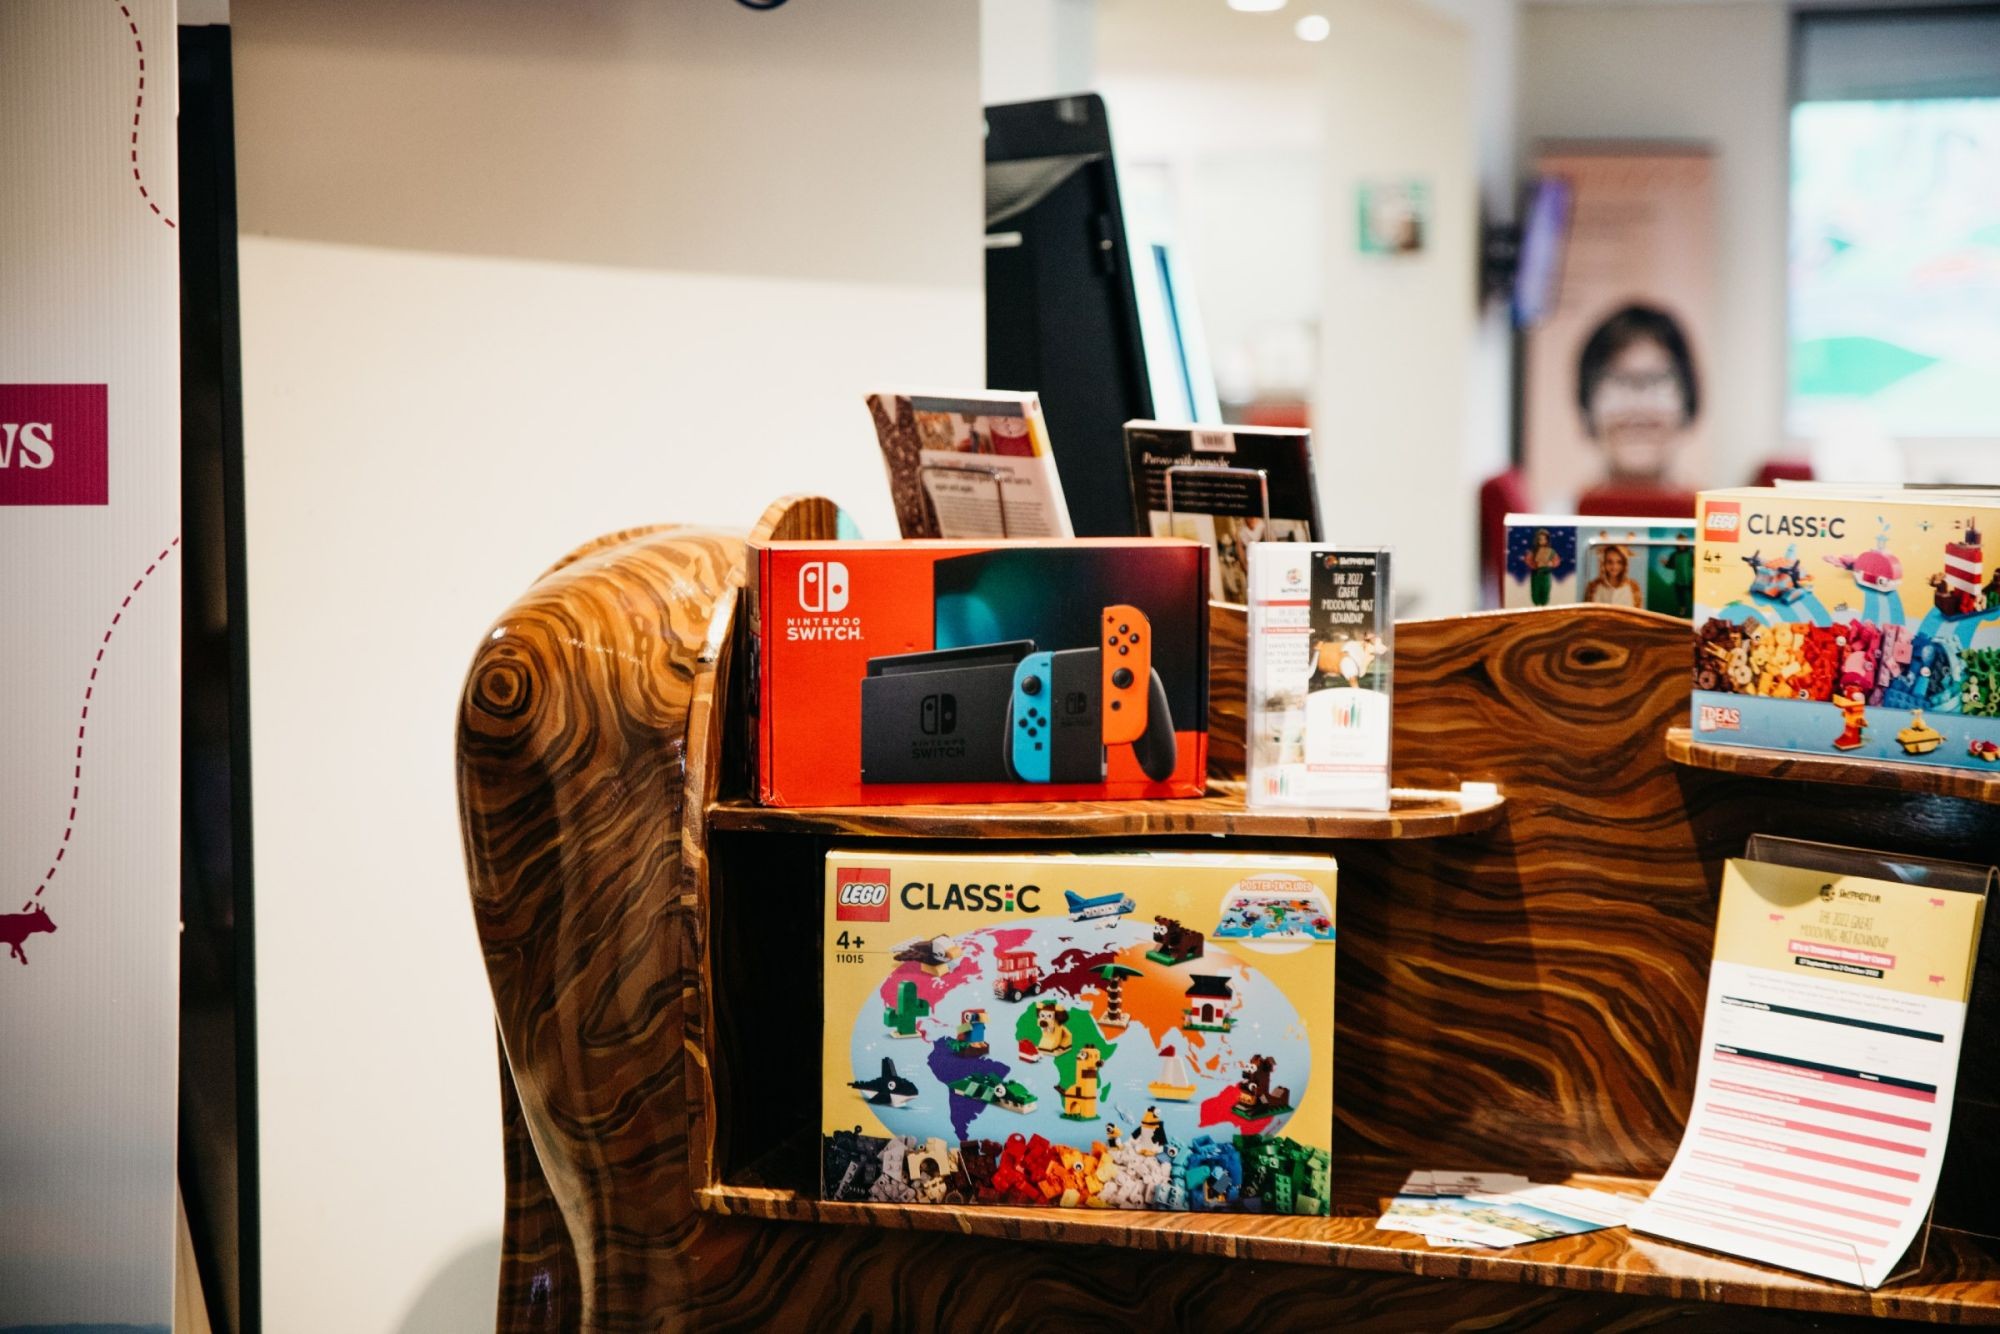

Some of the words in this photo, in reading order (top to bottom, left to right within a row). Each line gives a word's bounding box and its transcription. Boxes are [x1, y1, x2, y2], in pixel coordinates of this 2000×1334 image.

[1706, 512, 1739, 532] LEGO
[1333, 573, 1345, 585] THE
[1347, 573, 1364, 586] 2022
[1337, 586, 1360, 598] GREAT
[787, 618, 861, 626] NINTENDO
[787, 627, 860, 641] SWITCH
[911, 747, 966, 759] SWITCH
[840, 883, 888, 906] LEGO
[836, 931, 865, 949] 4+
[836, 954, 864, 964] 11015
